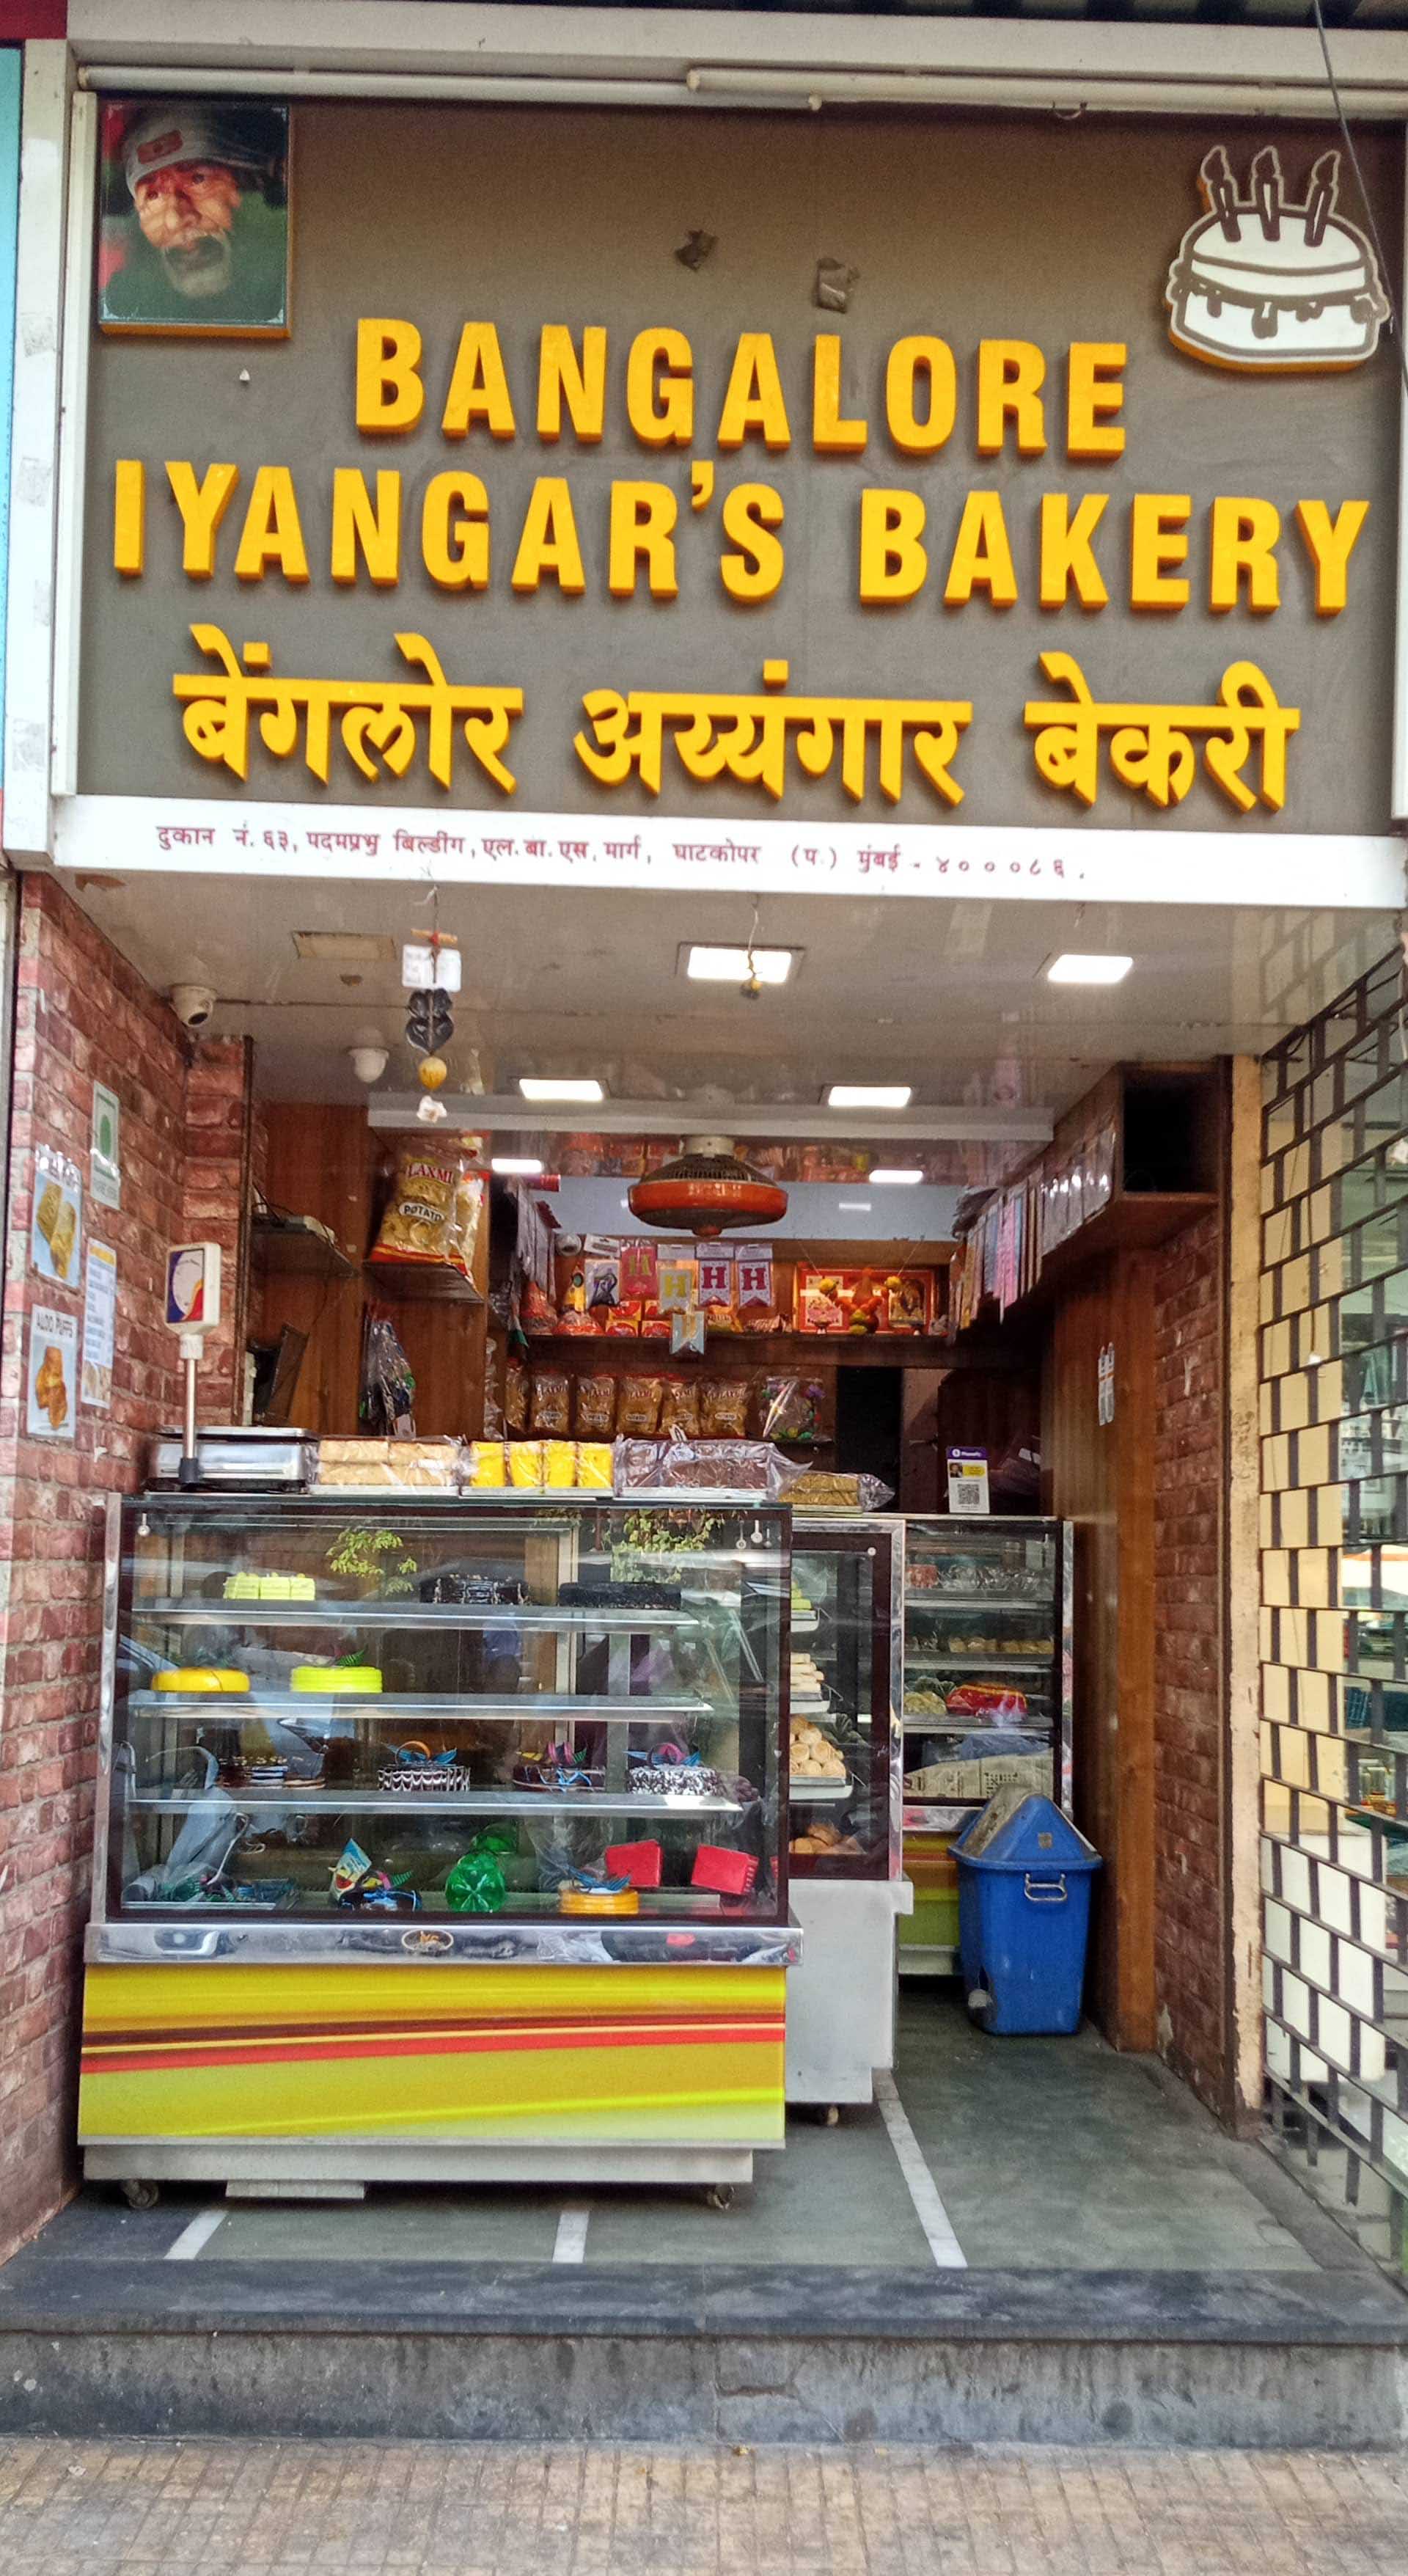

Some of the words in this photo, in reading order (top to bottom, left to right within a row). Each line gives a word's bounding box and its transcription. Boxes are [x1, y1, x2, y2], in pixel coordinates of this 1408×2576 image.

[356, 318, 1129, 456] BANGALORE
[113, 459, 785, 603] IYANGAR'S
[859, 489, 1371, 615] BAKERY
[173, 623, 525, 796] बेंगलोर
[573, 659, 974, 808] अय्यंगार
[1023, 651, 1302, 813] बेकरी
[155, 826, 216, 850] दुकान
[701, 1267, 726, 1289] H
[742, 1267, 766, 1290] H
